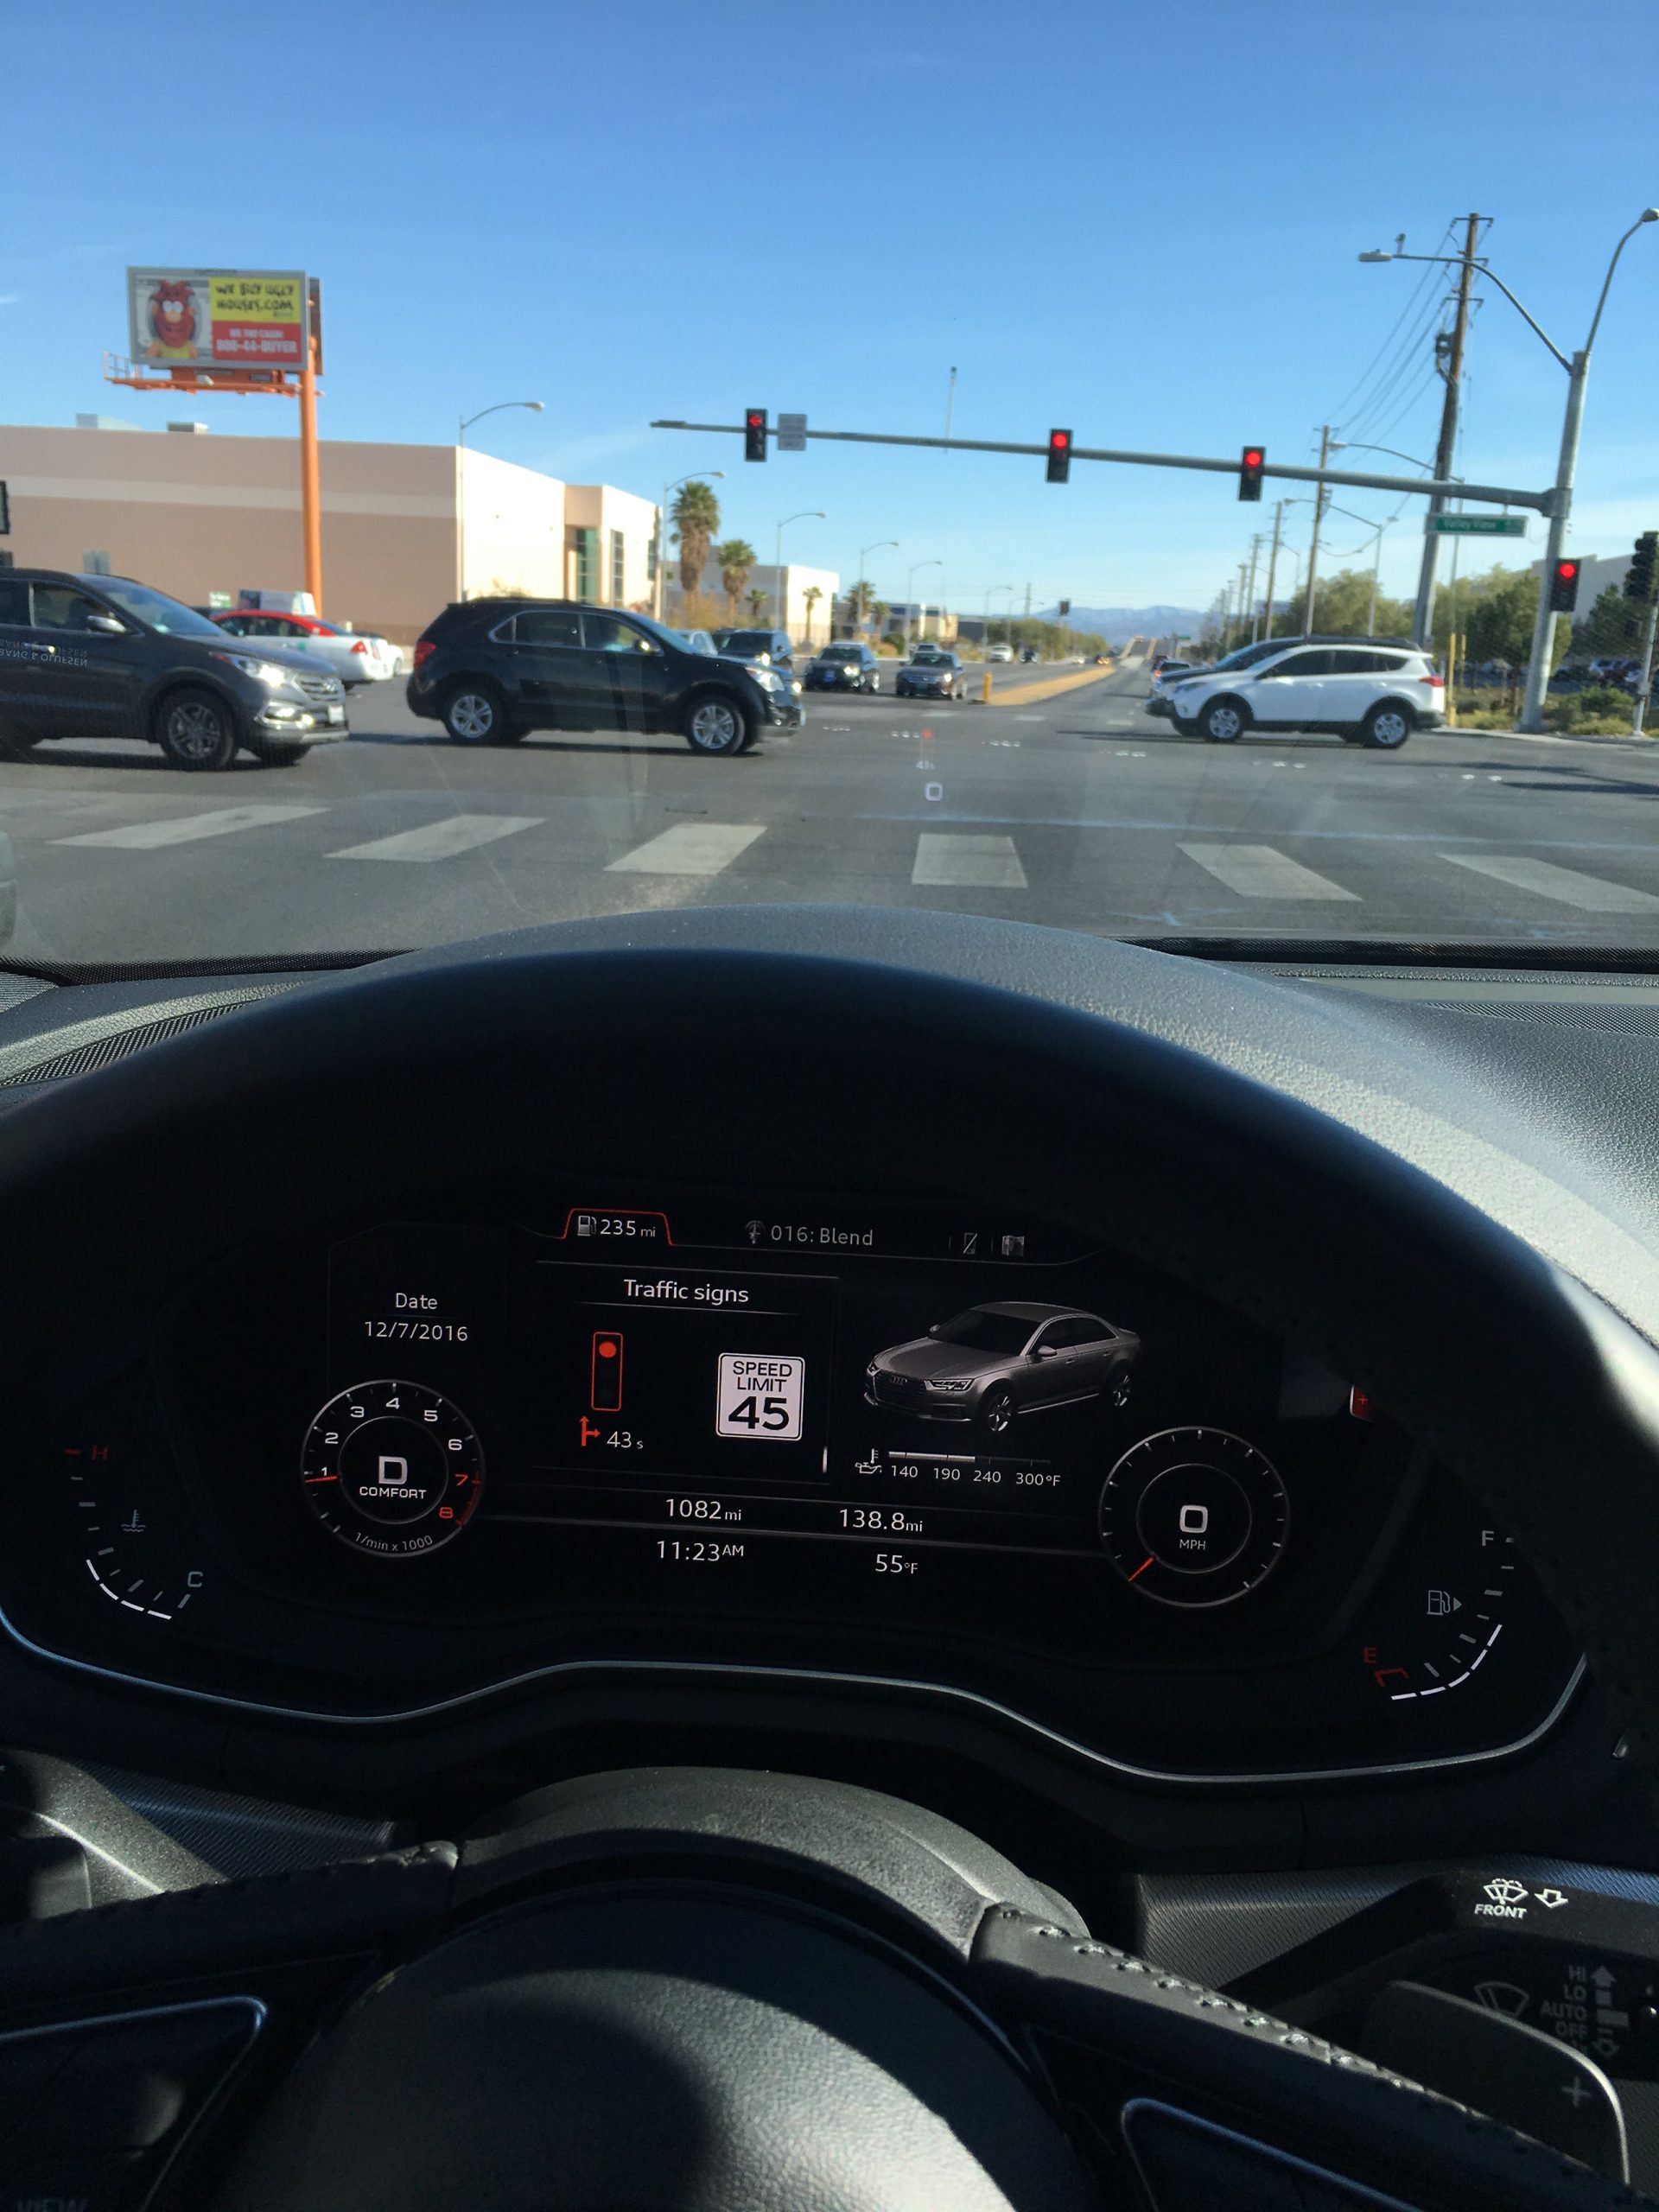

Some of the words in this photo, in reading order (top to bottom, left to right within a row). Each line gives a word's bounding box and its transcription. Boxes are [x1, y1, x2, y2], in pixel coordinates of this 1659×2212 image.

[216, 283, 233, 294] WE
[240, 283, 262, 296] BUY
[265, 283, 294, 296] UGLY
[600, 1218, 636, 1236] 235
[640, 1226, 656, 1237] mi
[771, 1224, 814, 1243] 016:
[820, 1227, 873, 1246] Blend
[395, 1292, 438, 1310] Date
[623, 1279, 689, 1300] Traffic
[694, 1283, 749, 1306] signs
[365, 1320, 468, 1342] 12/7/2016
[733, 1360, 792, 1379] SPEED
[737, 1376, 787, 1393] LIMIT
[350, 1405, 365, 1419] 3
[385, 1396, 400, 1410] 4
[423, 1409, 438, 1422] 5
[728, 1395, 790, 1431] 45
[324, 1432, 340, 1445] 2
[448, 1438, 463, 1451] 6
[606, 1430, 632, 1449] 43
[321, 1466, 327, 1477] 1
[378, 1455, 408, 1485] D
[891, 1465, 918, 1478] 140
[933, 1467, 961, 1481] 190
[973, 1470, 1001, 1484] 240
[455, 1473, 468, 1486] 7
[359, 1485, 428, 1499] COMFORT
[438, 1506, 454, 1519] 8
[402, 1535, 435, 1553] 1000
[1179, 1539, 1206, 1550] MPH
[1481, 1529, 1495, 1547] F
[187, 1570, 204, 1588] C
[1363, 1646, 1376, 1664] E
[1474, 1904, 1528, 1919] FRONT
[1568, 1965, 1586, 1981] HI
[1563, 1984, 1586, 2002] LO
[1540, 2000, 1587, 2021] AUTO
[1555, 2020, 1589, 2039] OFF
